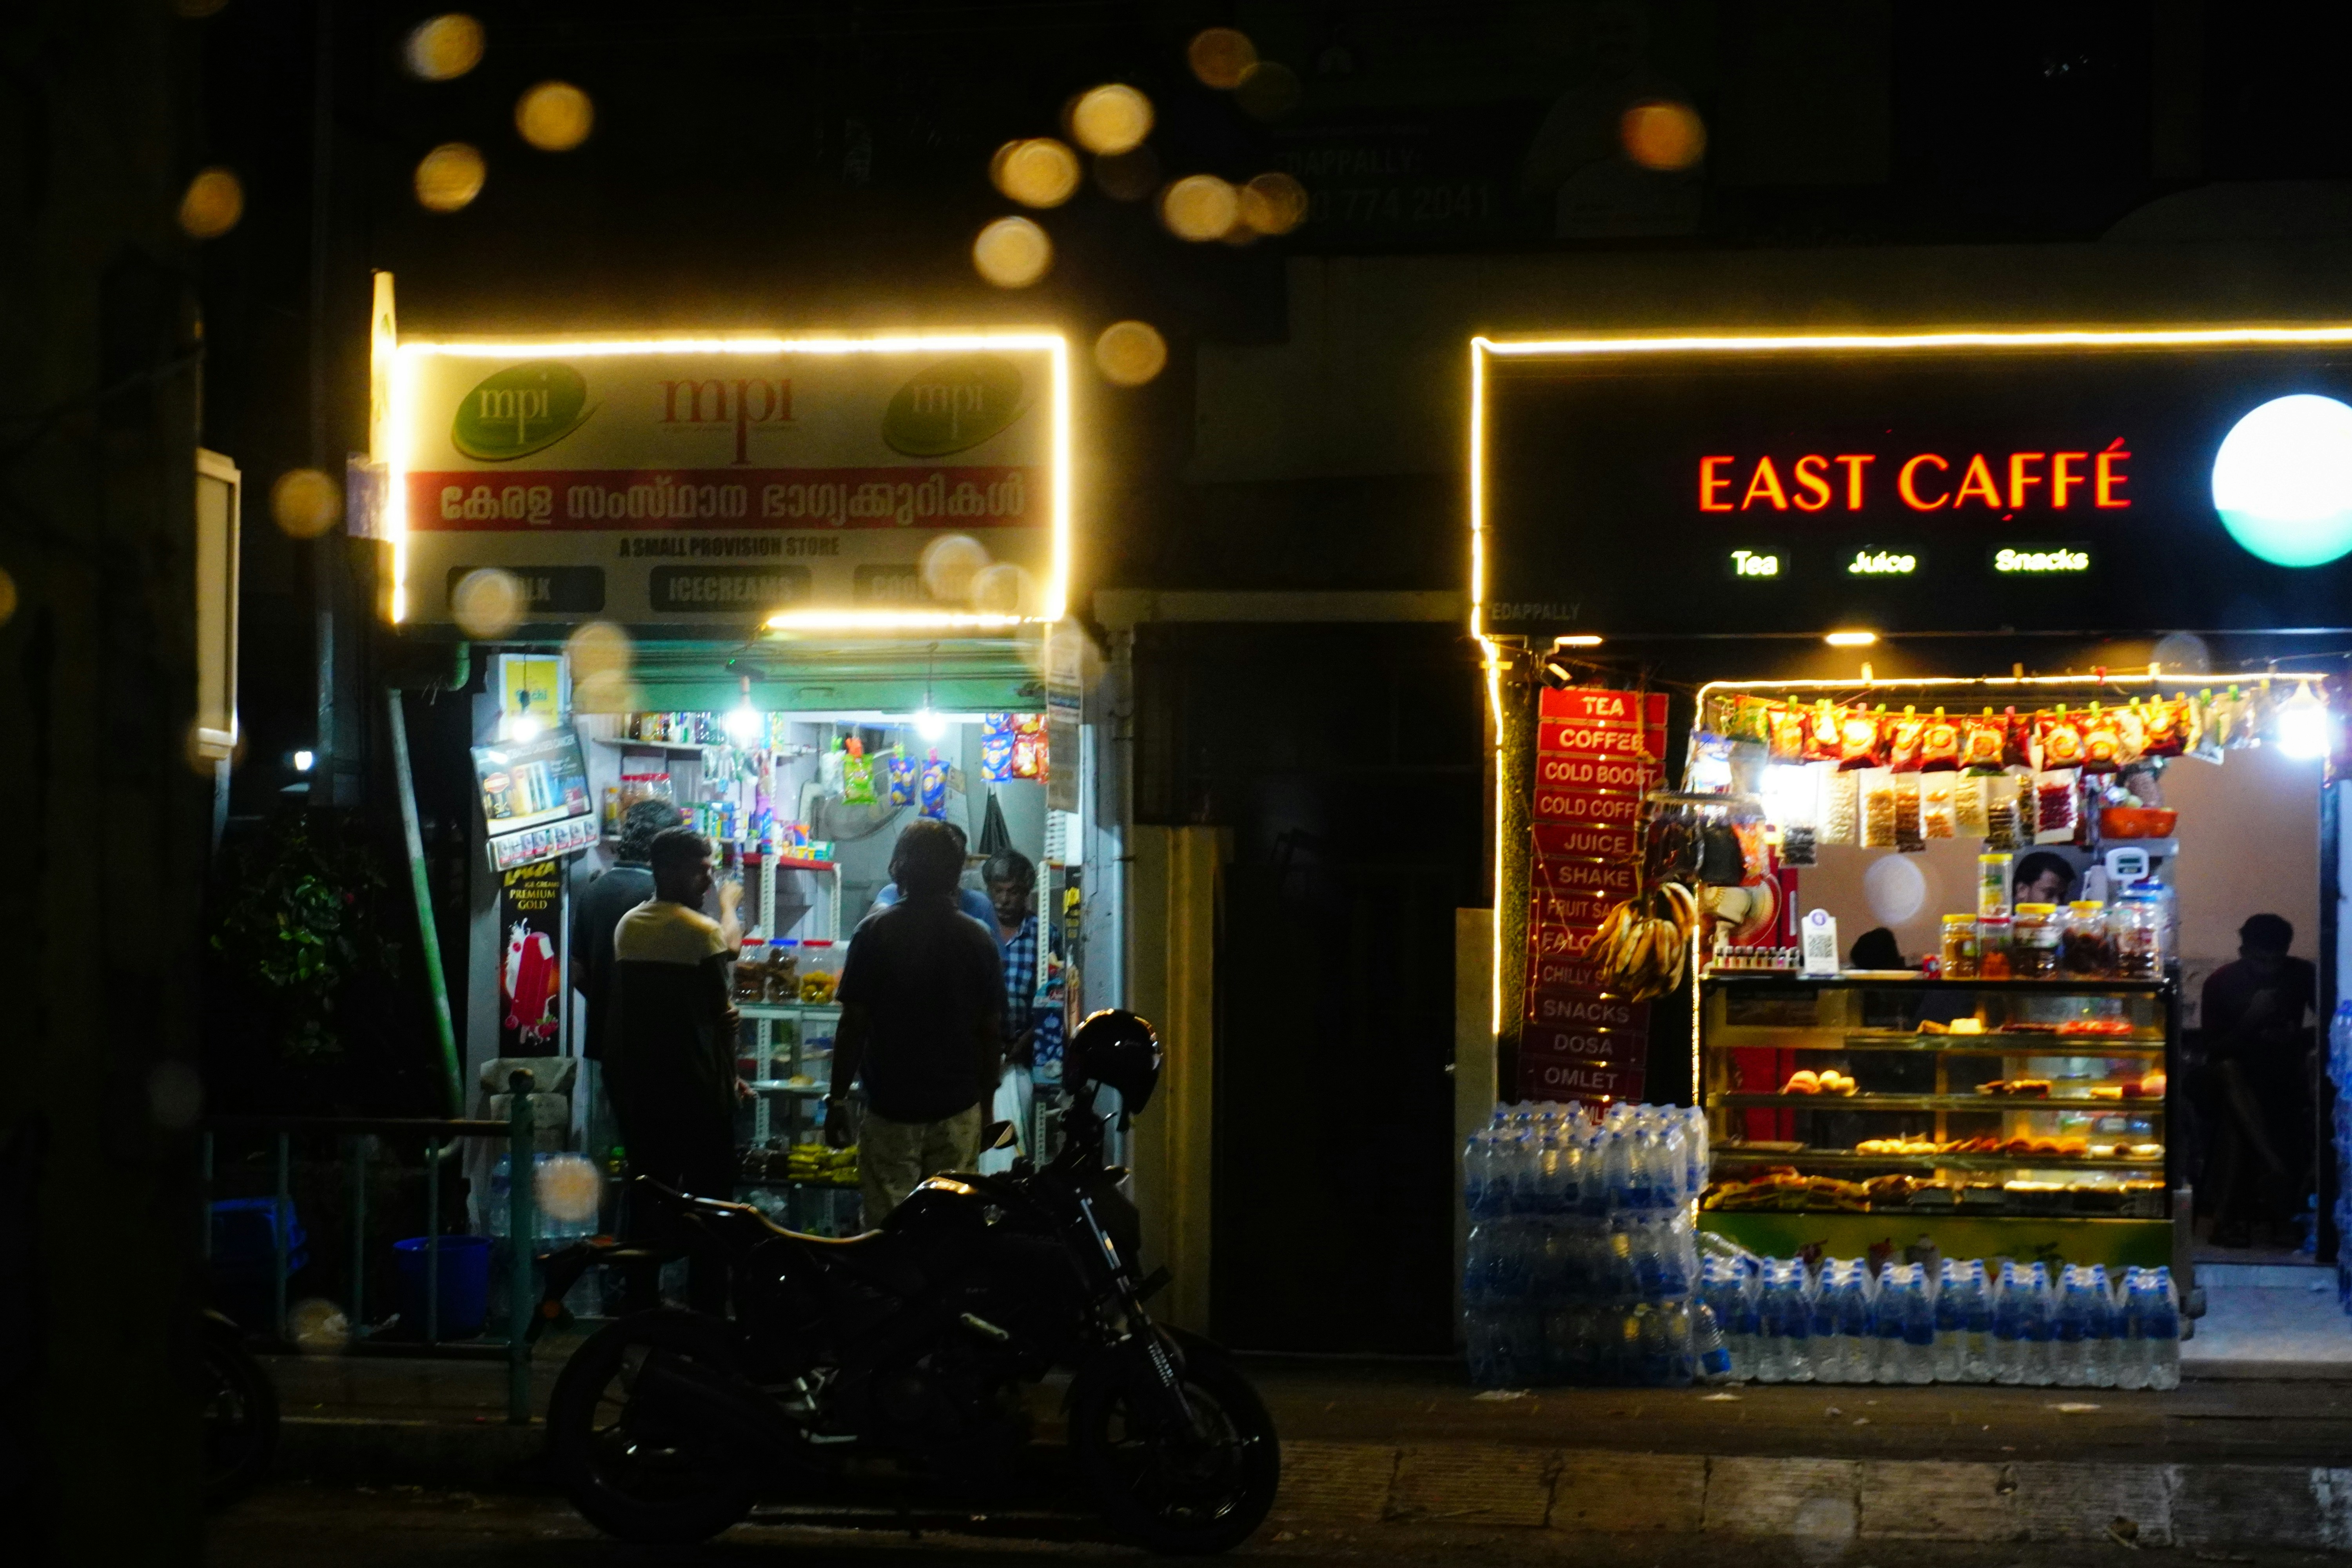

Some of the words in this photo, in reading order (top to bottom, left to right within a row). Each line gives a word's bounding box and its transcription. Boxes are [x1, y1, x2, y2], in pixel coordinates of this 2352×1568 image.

[1340, 187, 1401, 222] 774
[1412, 183, 1490, 221] 2041
[479, 373, 548, 444] mpi
[913, 382, 985, 440] mpi
[656, 377, 798, 465] mpi
[1699, 454, 1876, 512] EAST
[1897, 436, 2131, 510] CAFFÉ
[440, 485, 552, 524] കേരള
[567, 475, 748, 520] സംസ്ഥാന
[619, 537, 630, 557] A
[632, 537, 686, 556] SMALL
[690, 537, 781, 556] PROVISION
[786, 536, 840, 555] STORE
[1730, 550, 1778, 575] Tea
[1848, 550, 1916, 574] Juice
[1994, 548, 2089, 572] Snacks
[669, 576, 792, 602] ICECREAMS
[1492, 603, 1581, 620] EDAPPALLY
[1582, 696, 1625, 717] TEA
[1559, 729, 1645, 752] COFFEE
[1544, 761, 1593, 782] COLD
[1540, 796, 1586, 816] COLD
[1590, 799, 1636, 819] COFF
[1564, 833, 1628, 852] JUICE
[1559, 866, 1630, 887] SHAKE
[510, 889, 556, 899] PREMIUM
[517, 900, 548, 910] GOLD
[1548, 900, 1589, 917] FRUIT
[1543, 965, 1593, 982] CHILLY
[1543, 999, 1631, 1023] SNACKS
[1553, 1034, 1613, 1056] DOSA
[1544, 1067, 1619, 1090] OMLET
